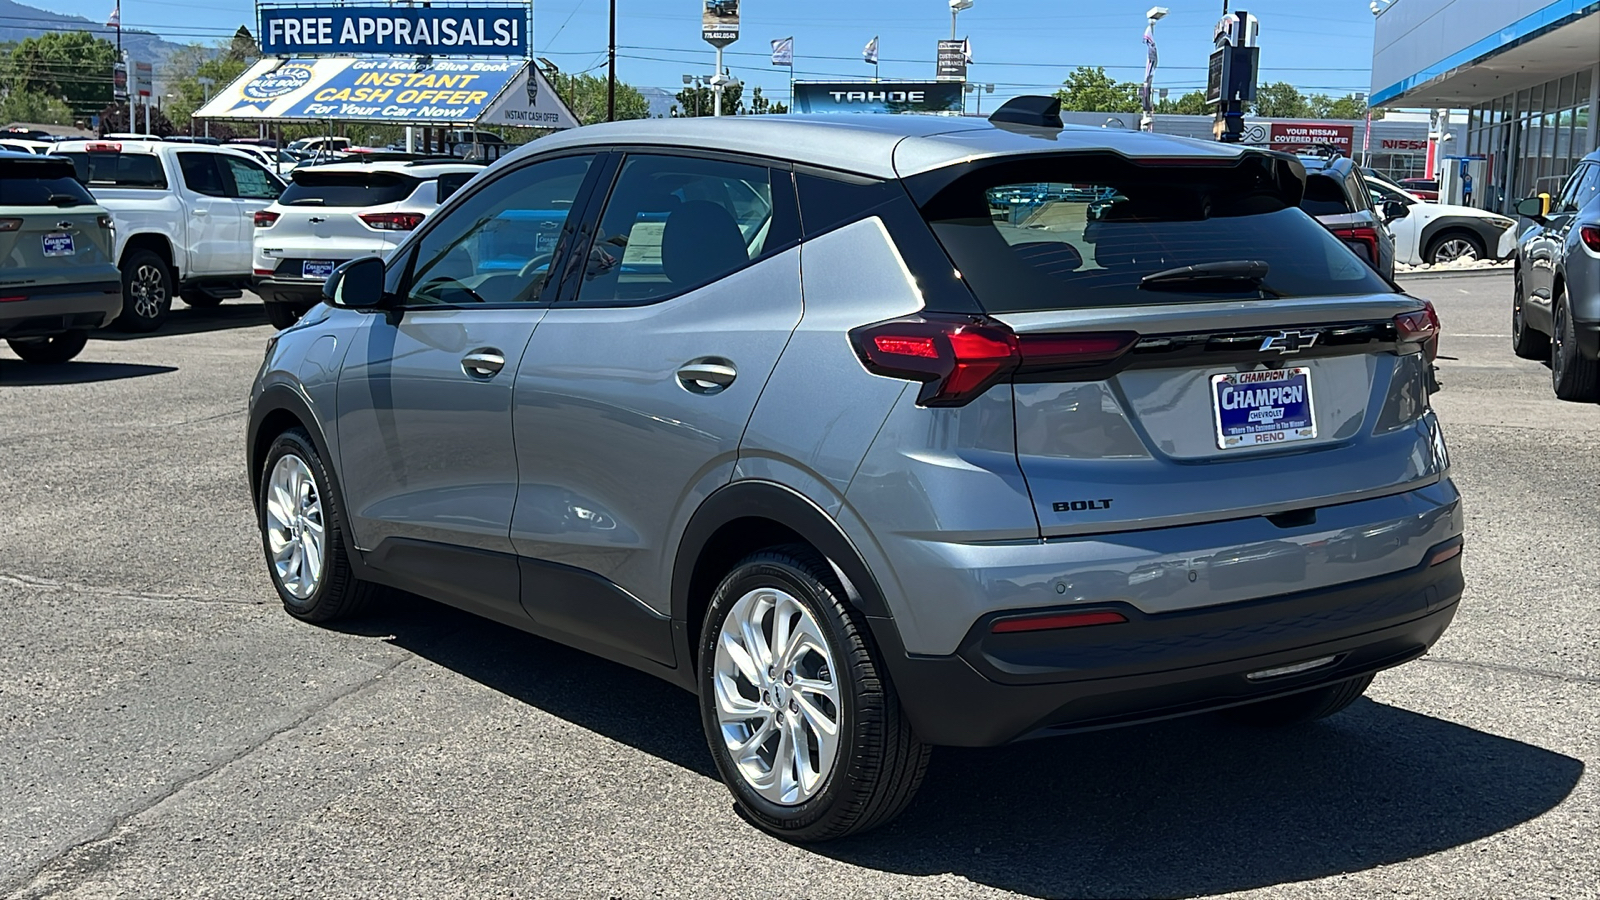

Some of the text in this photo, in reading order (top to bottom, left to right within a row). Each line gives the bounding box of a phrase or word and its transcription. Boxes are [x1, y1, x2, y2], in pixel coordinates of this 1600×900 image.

[269, 17, 519, 46] FREE APPRAISALS!
[352, 61, 376, 70] Get
[434, 62, 470, 72] Blue
[353, 72, 480, 88] INSTANT
[314, 88, 489, 104] CASH OFFER
[829, 91, 925, 103] TAHOE
[303, 103, 469, 118] For Your Car Now!
[504, 109, 560, 122] INSTANT CASH OFFER
[1286, 128, 1308, 136] YOUR
[1274, 135, 1312, 143] COVERED
[1382, 140, 1428, 150] NISSA
[1240, 370, 1285, 383] CHAMPION
[1221, 385, 1303, 410] CHAMPION
[1250, 410, 1282, 419] CHEVROLET
[1246, 425, 1255, 433] The
[1255, 432, 1285, 443] RENO
[1052, 499, 1114, 512] BOLT
